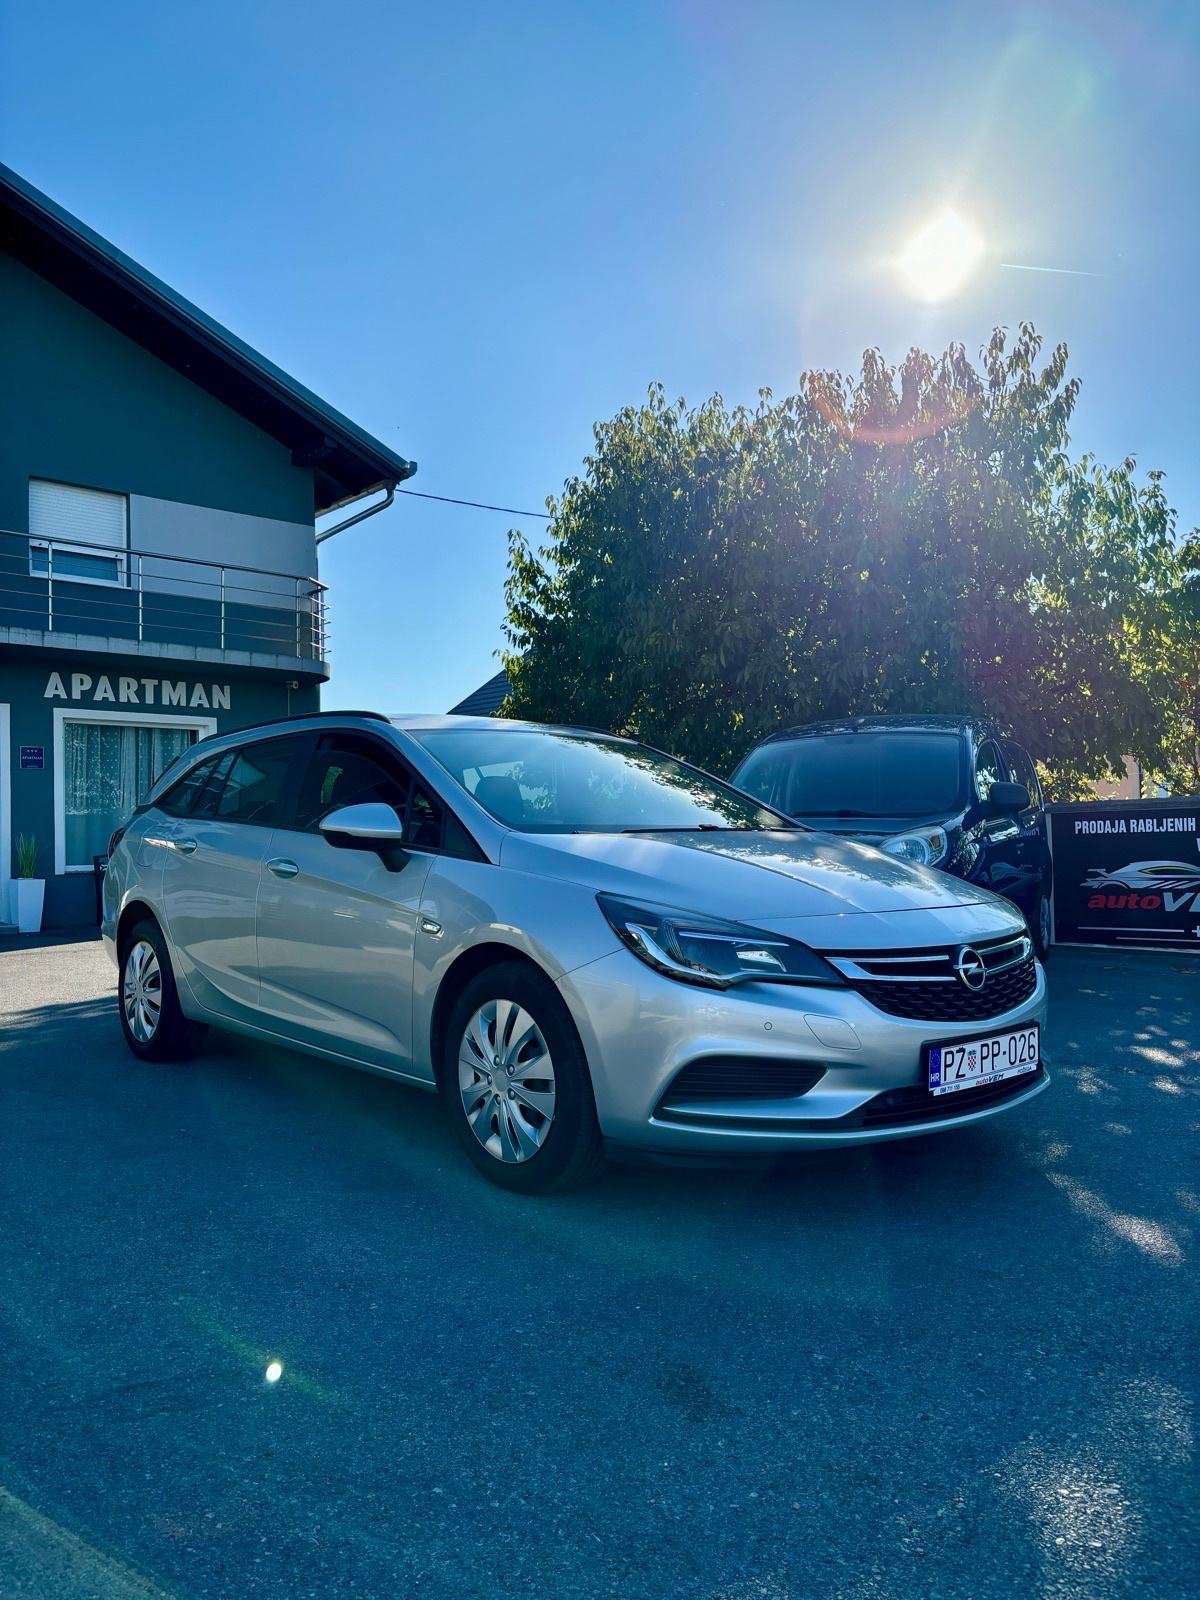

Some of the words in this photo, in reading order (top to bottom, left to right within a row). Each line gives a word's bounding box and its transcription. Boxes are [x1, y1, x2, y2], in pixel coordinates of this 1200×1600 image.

[43, 671, 231, 709] APARTMAN
[1074, 819, 1127, 834] PRODAJA
[1129, 817, 1196, 833] RABLJENIH
[980, 1030, 1037, 1073] PP-026
[930, 1073, 941, 1083] HR
[975, 1073, 1004, 1085] autoVEM
